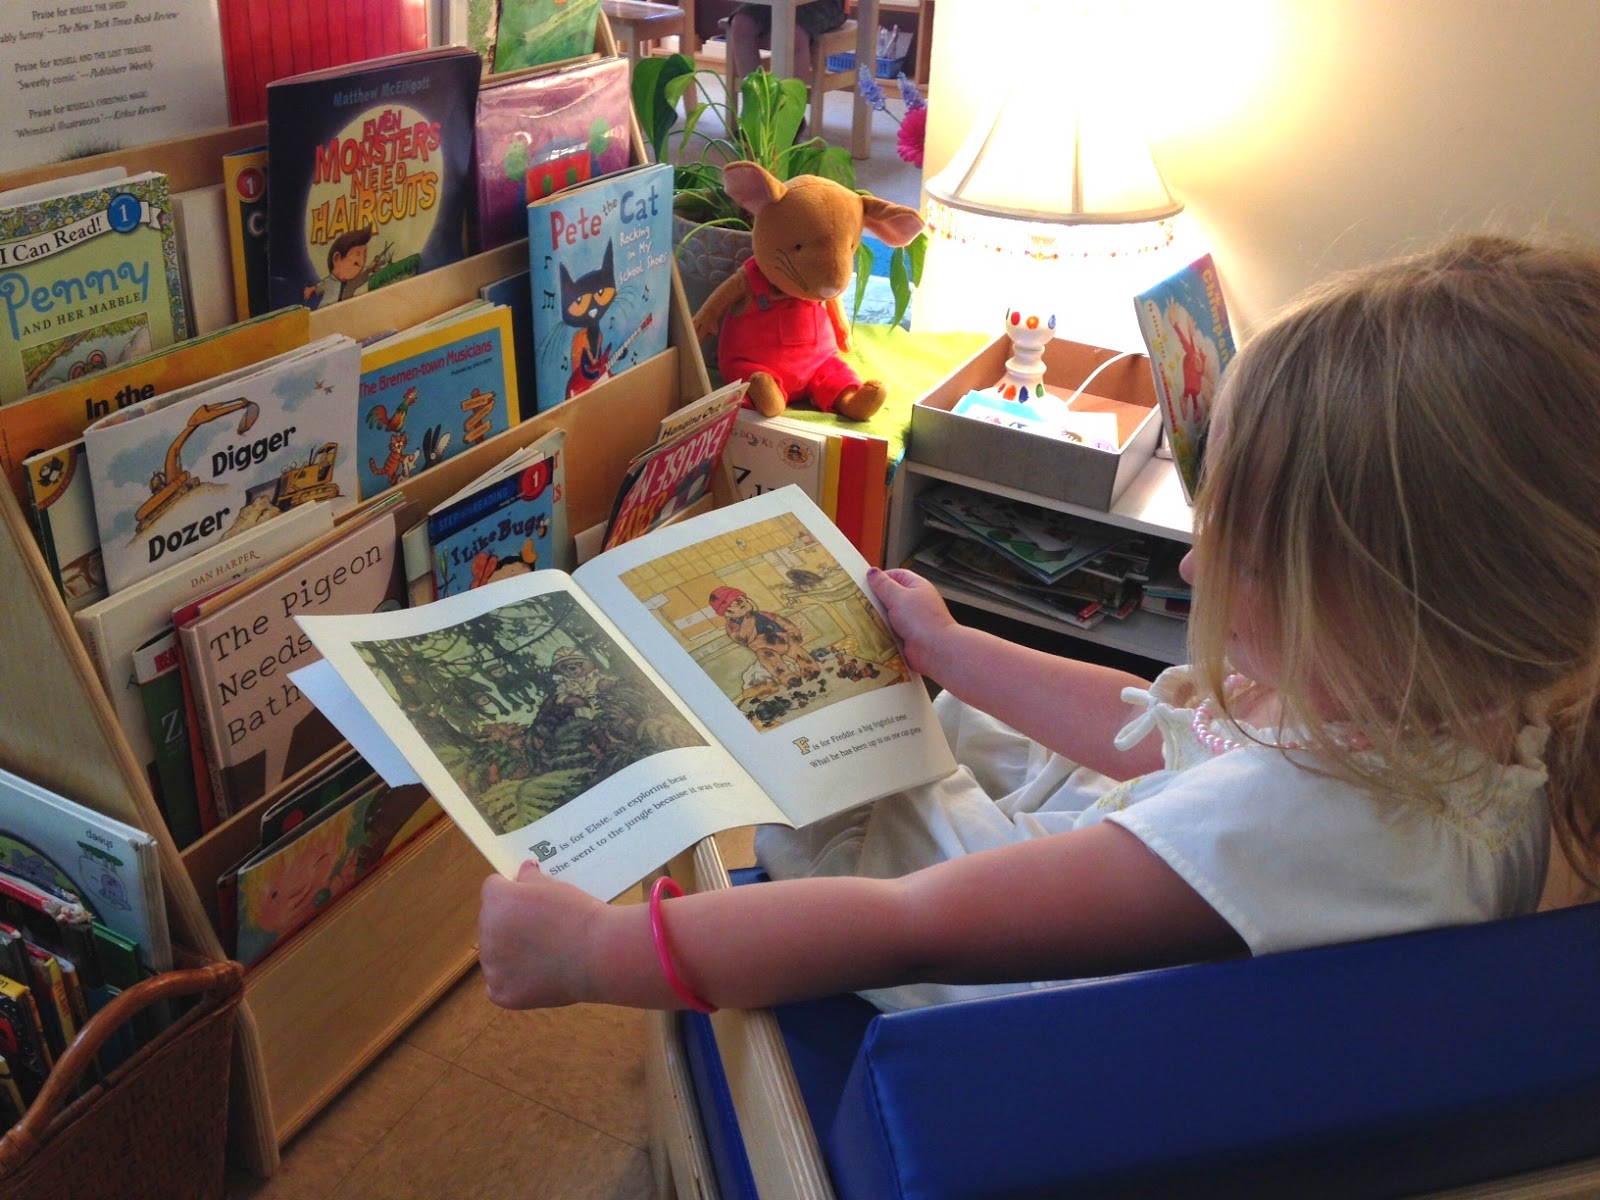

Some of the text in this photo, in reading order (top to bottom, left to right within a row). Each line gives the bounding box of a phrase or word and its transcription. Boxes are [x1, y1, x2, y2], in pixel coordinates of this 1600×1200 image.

[32, 10, 55, 20] Praise
[57, 7, 68, 17] for
[74, 22, 90, 32] New
[94, 19, 109, 29] York
[134, 13, 152, 24] Book
[14, 63, 38, 72] Praise
[40, 59, 51, 68] for
[79, 53, 93, 62] AND
[94, 51, 106, 59] THE
[29, 109, 51, 119] Praise
[53, 105, 65, 114] for
[334, 87, 379, 107] Matthew
[363, 109, 402, 143] EVEN
[313, 121, 443, 184] MONSTERS
[350, 161, 407, 199] NEED
[119, 204, 128, 222] 1
[550, 185, 659, 251] Pete the Cat
[0, 216, 103, 265] I Can Read!
[620, 225, 651, 247] Rocking
[628, 249, 636, 260] in
[0, 261, 150, 341] Penny
[22, 291, 142, 337] AND HER MARBLE
[86, 383, 156, 420] In the
[359, 382, 377, 399] The
[212, 426, 297, 478] Digger
[533, 471, 539, 488] 1
[148, 507, 231, 564] Dozer
[451, 546, 460, 566] I
[462, 530, 497, 563] Like
[191, 570, 213, 588] DAN
[216, 550, 261, 576] HARPER
[210, 544, 383, 662] The Pigeon
[218, 632, 313, 707] Needs
[227, 682, 301, 746] Bath
[793, 736, 811, 755] F
[812, 743, 821, 751] is
[820, 738, 831, 747] for
[862, 723, 874, 732] big
[810, 756, 831, 768] What
[830, 751, 841, 761] he
[840, 747, 853, 757] has
[852, 743, 868, 753] been
[528, 840, 557, 863] E
[559, 842, 570, 851] is
[570, 831, 585, 844] for
[613, 805, 627, 817] an
[627, 781, 670, 808] exploring
[667, 774, 687, 786] bear
[549, 861, 570, 876] She
[571, 845, 595, 863] went
[596, 837, 608, 847] to
[607, 826, 625, 839] the
[624, 808, 654, 831] jungle
[652, 789, 689, 810] because
[689, 786, 697, 794] it
